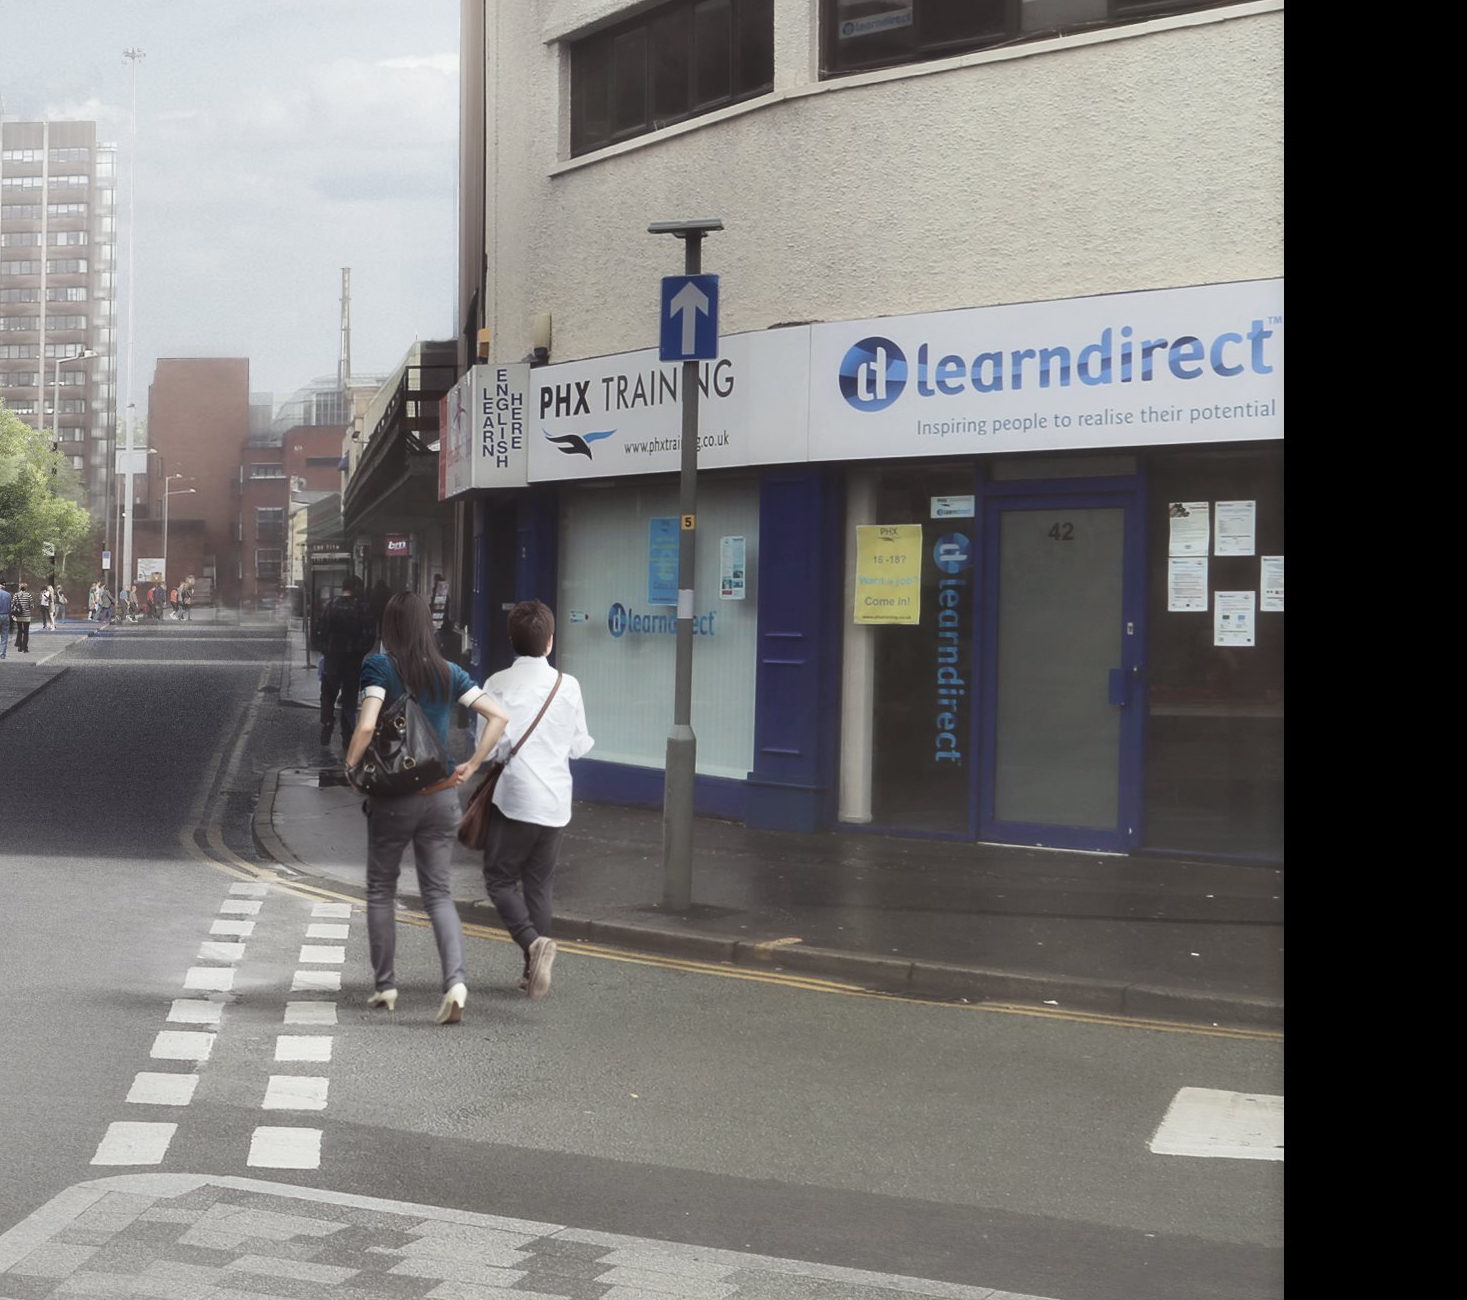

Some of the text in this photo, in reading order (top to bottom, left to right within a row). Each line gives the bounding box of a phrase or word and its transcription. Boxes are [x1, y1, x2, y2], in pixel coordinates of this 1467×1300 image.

[917, 319, 1274, 398] learndirect
[540, 359, 735, 419] PHX TRAINNG
[482, 387, 494, 457] LEARN
[496, 368, 509, 468] ENGLISH
[511, 392, 523, 449] HERE
[916, 400, 1276, 437] Inspiring people to realise their potential
[684, 517, 693, 528] 5
[880, 527, 899, 536] PHX
[1047, 522, 1075, 541] 42
[864, 596, 895, 606] Come
[935, 579, 967, 762] learndirect
